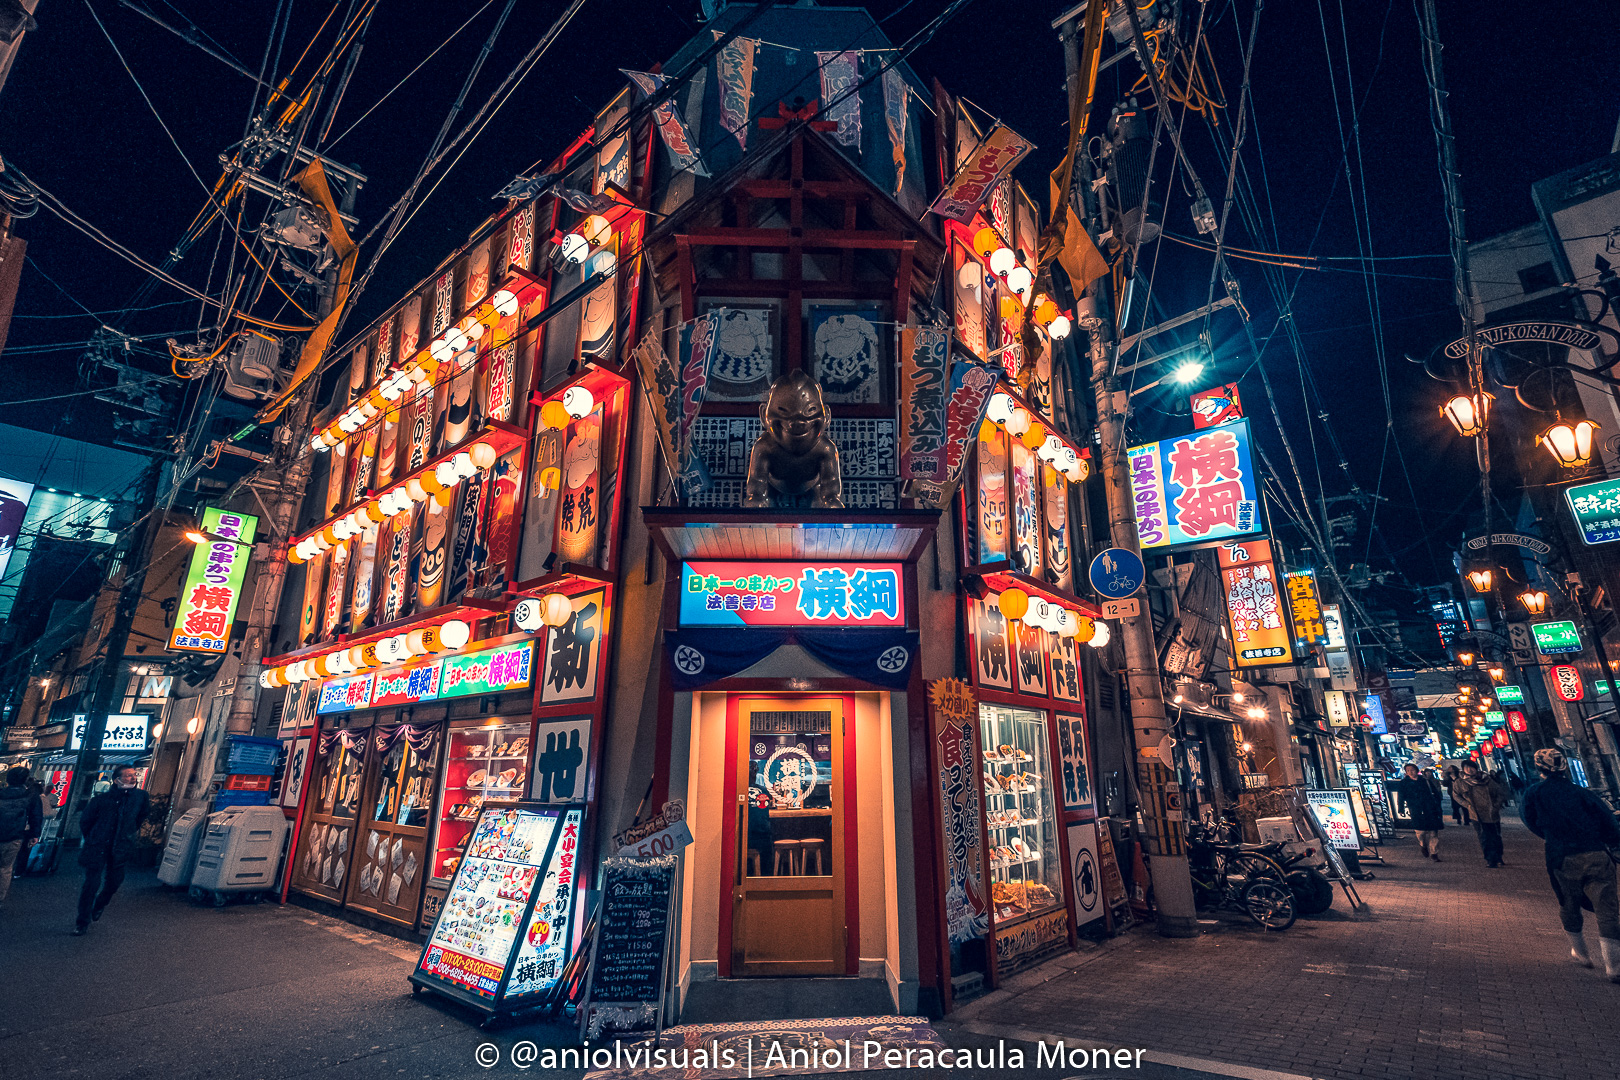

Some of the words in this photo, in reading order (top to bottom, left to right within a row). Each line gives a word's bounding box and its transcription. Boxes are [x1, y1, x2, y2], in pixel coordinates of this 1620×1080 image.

[908, 344, 944, 454] もつ煮込み
[858, 440, 868, 476] ホルモン
[877, 420, 894, 459] 串かつ
[1131, 454, 1163, 545] 日本一の串かつ
[1169, 430, 1244, 537] 横綱
[1237, 501, 1254, 532] 法善寺
[205, 513, 241, 584] 日本の串かつ
[688, 574, 794, 593] 日本一の串かつ
[706, 595, 776, 610] 法善寺店
[797, 567, 899, 620] 横綱
[187, 583, 234, 637] 横綱
[1287, 575, 1326, 643] 営業中
[175, 636, 225, 650] 法善寺店
[547, 601, 598, 693] 新
[980, 600, 1009, 683] 横
[407, 667, 432, 697] 横綱
[449, 662, 489, 687] 日本一の串かつ
[488, 650, 522, 685] 横綱
[346, 679, 367, 706] 横綱
[939, 696, 970, 715] メガ盛り
[539, 729, 584, 799] 世
[551, 823, 578, 946] 大小宴会承り中!!
[516, 959, 556, 984] 横綱
